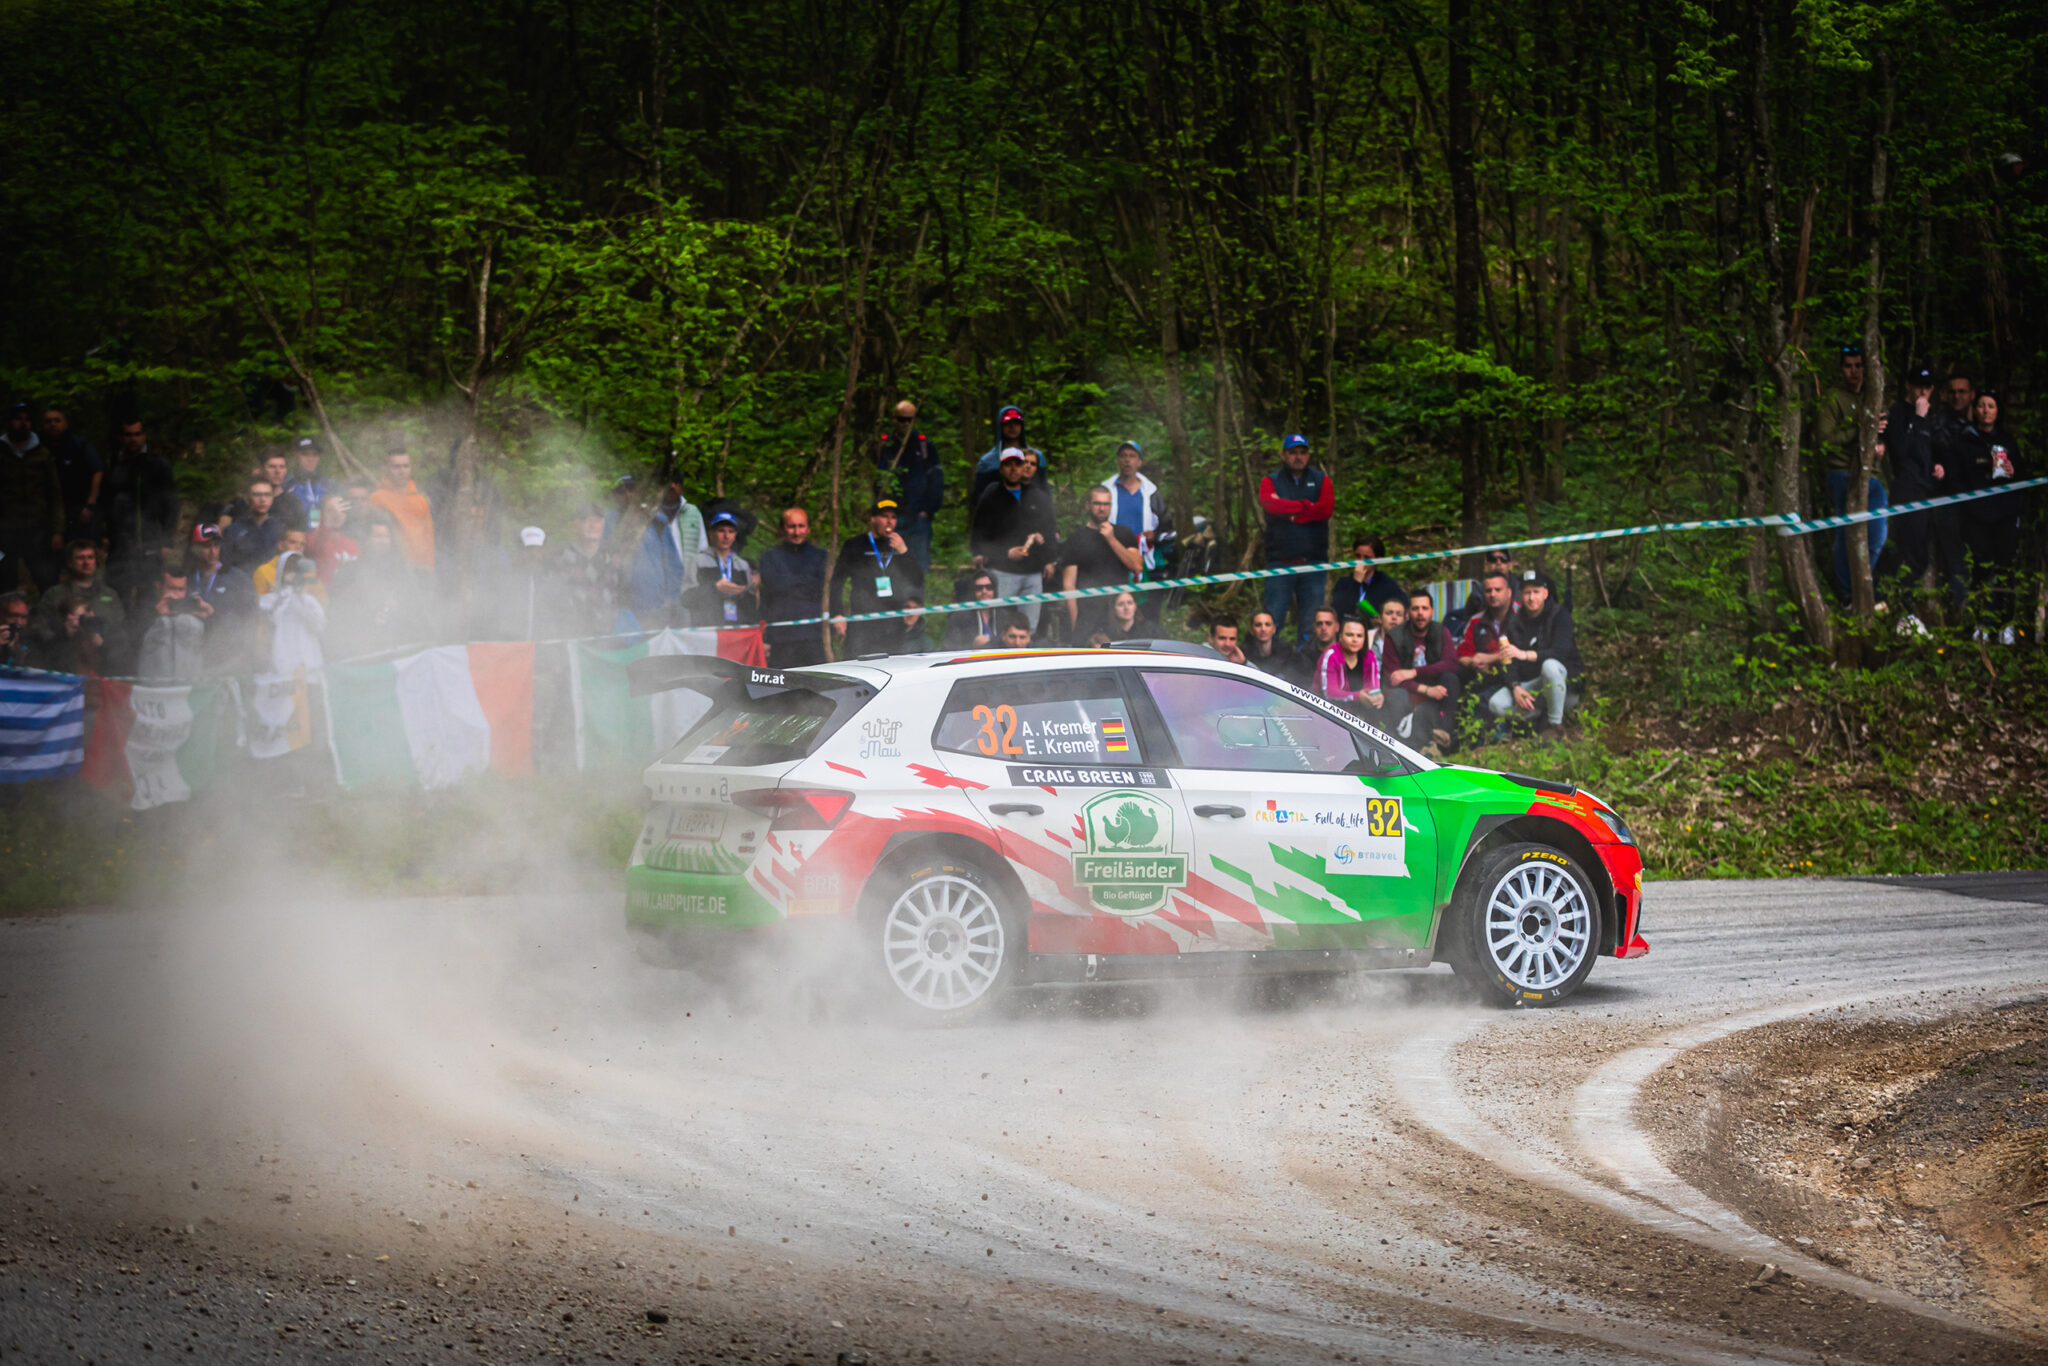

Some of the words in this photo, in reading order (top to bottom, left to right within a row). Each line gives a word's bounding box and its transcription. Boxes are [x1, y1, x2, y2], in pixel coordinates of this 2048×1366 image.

[751, 670, 785, 685] brr.at
[1290, 684, 1396, 747] WWW.LANDPUTE.DE
[862, 718, 903, 745] Wuff
[972, 704, 1024, 756] 32
[1022, 721, 1040, 737] A.
[1042, 720, 1097, 737] Kremer
[1026, 739, 1043, 755] E.
[1046, 738, 1100, 755] Kremer
[1022, 769, 1075, 784] CRAIG
[1077, 770, 1136, 785] BREEN
[1315, 812, 1334, 825] Full
[1368, 799, 1401, 836] 32
[1521, 851, 1568, 866] PZERO
[1083, 862, 1177, 879] Freiländer
[1103, 891, 1116, 900] Bio
[1117, 891, 1153, 901] Geflügel
